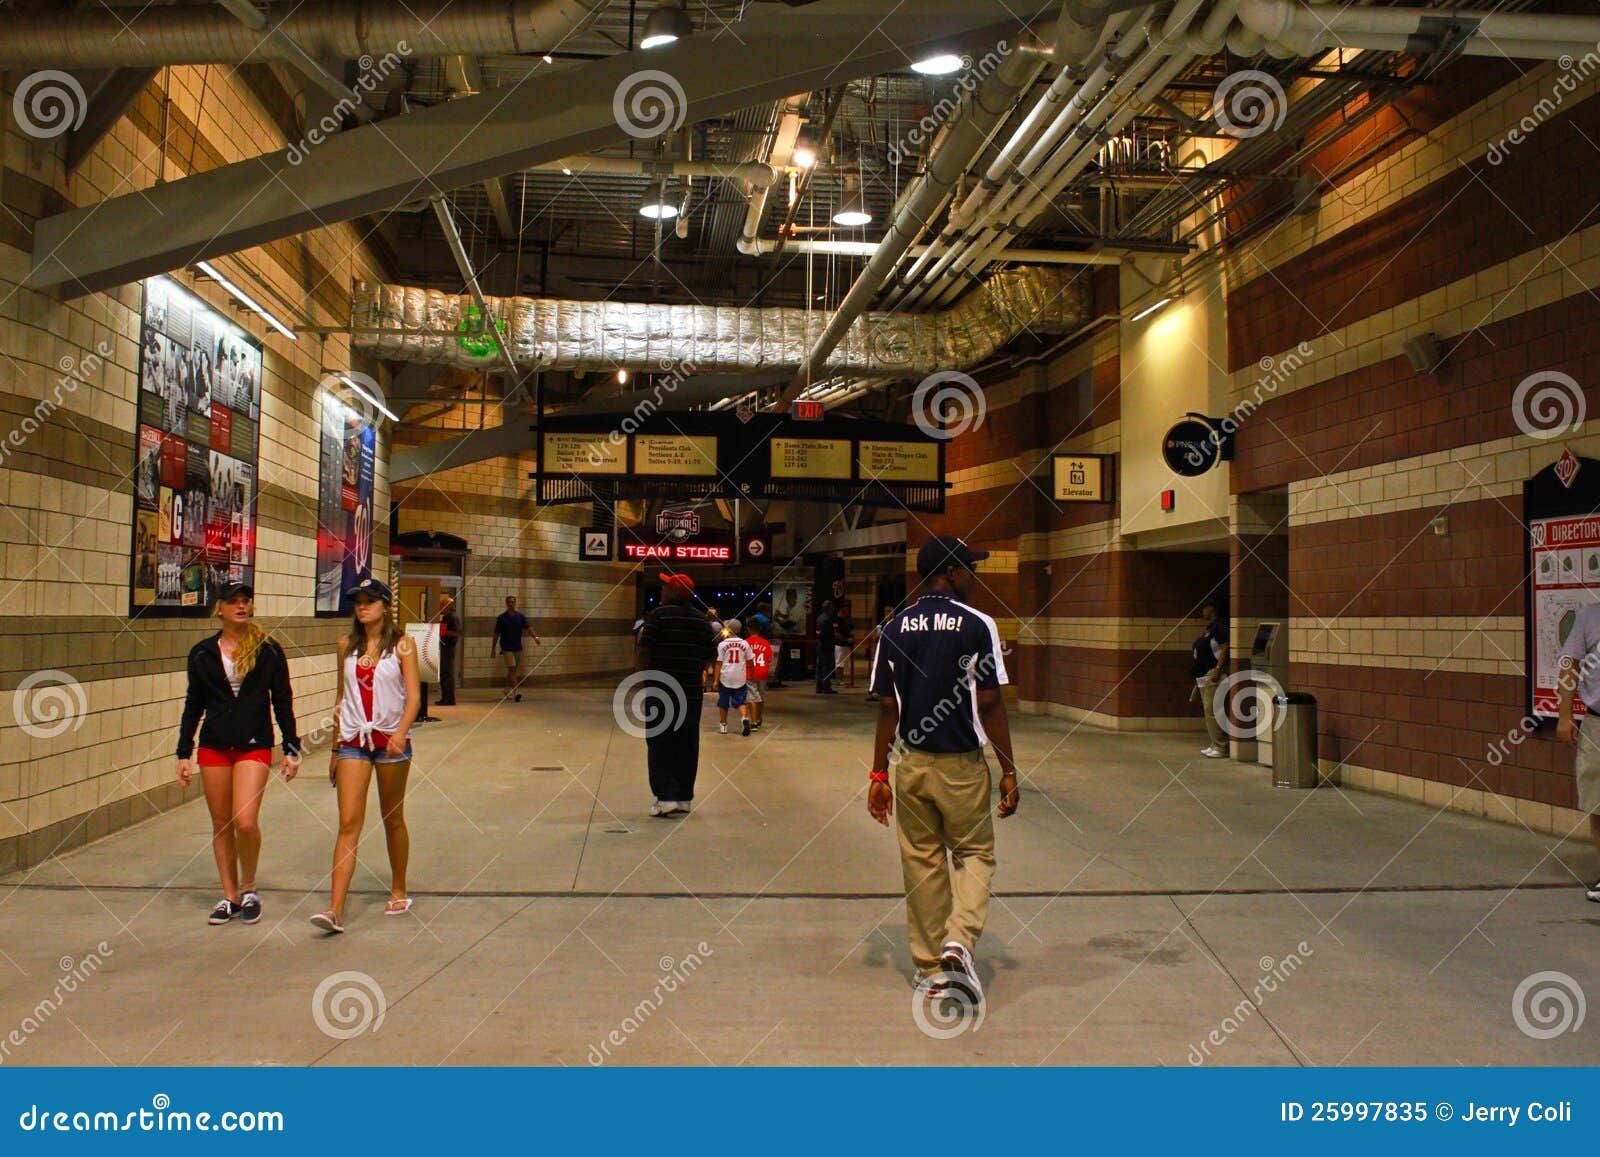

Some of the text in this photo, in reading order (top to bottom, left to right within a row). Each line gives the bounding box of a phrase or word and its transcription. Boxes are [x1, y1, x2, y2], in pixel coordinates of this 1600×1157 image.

[797, 404, 822, 418] EXIT
[1063, 488, 1093, 496] Elevator
[658, 517, 698, 532] NATIONALS
[625, 545, 729, 559] TEAM STORE
[900, 613, 963, 633] Ask Me!
[728, 649, 740, 664] 11
